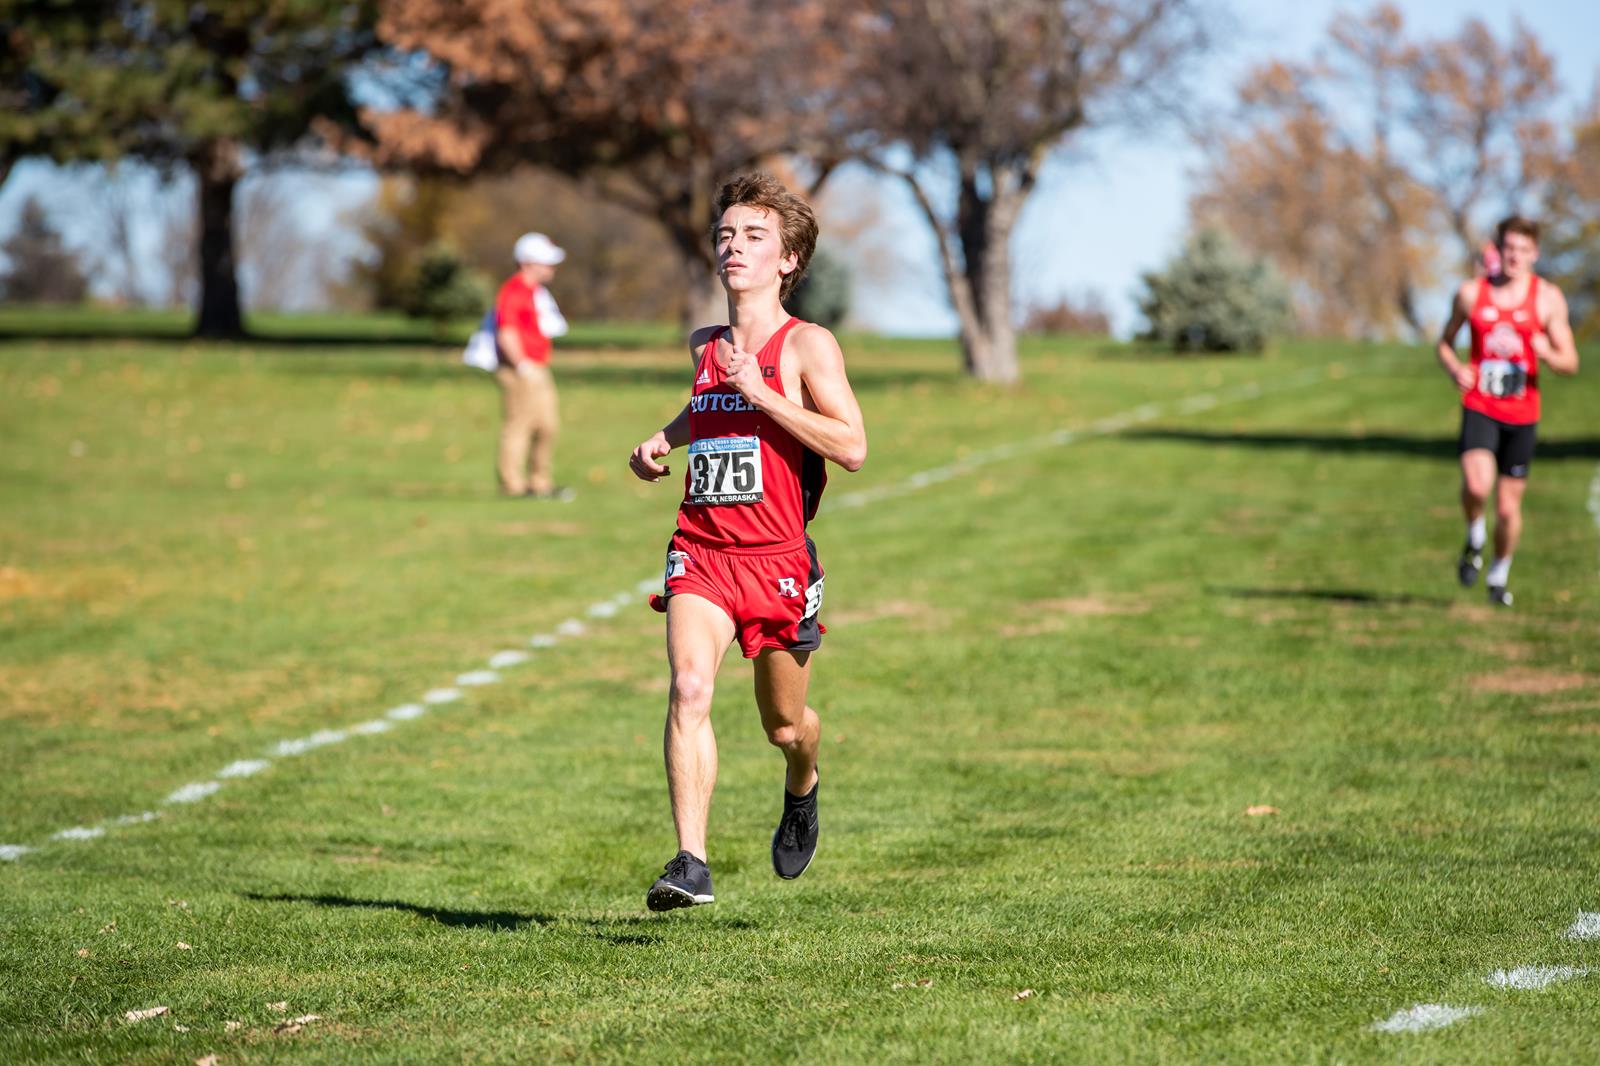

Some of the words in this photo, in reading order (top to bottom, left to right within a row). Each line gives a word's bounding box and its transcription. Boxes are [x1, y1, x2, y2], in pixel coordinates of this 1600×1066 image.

[694, 451, 756, 493] 375
[720, 494, 757, 503] NEBRASKA
[778, 577, 799, 598] R
